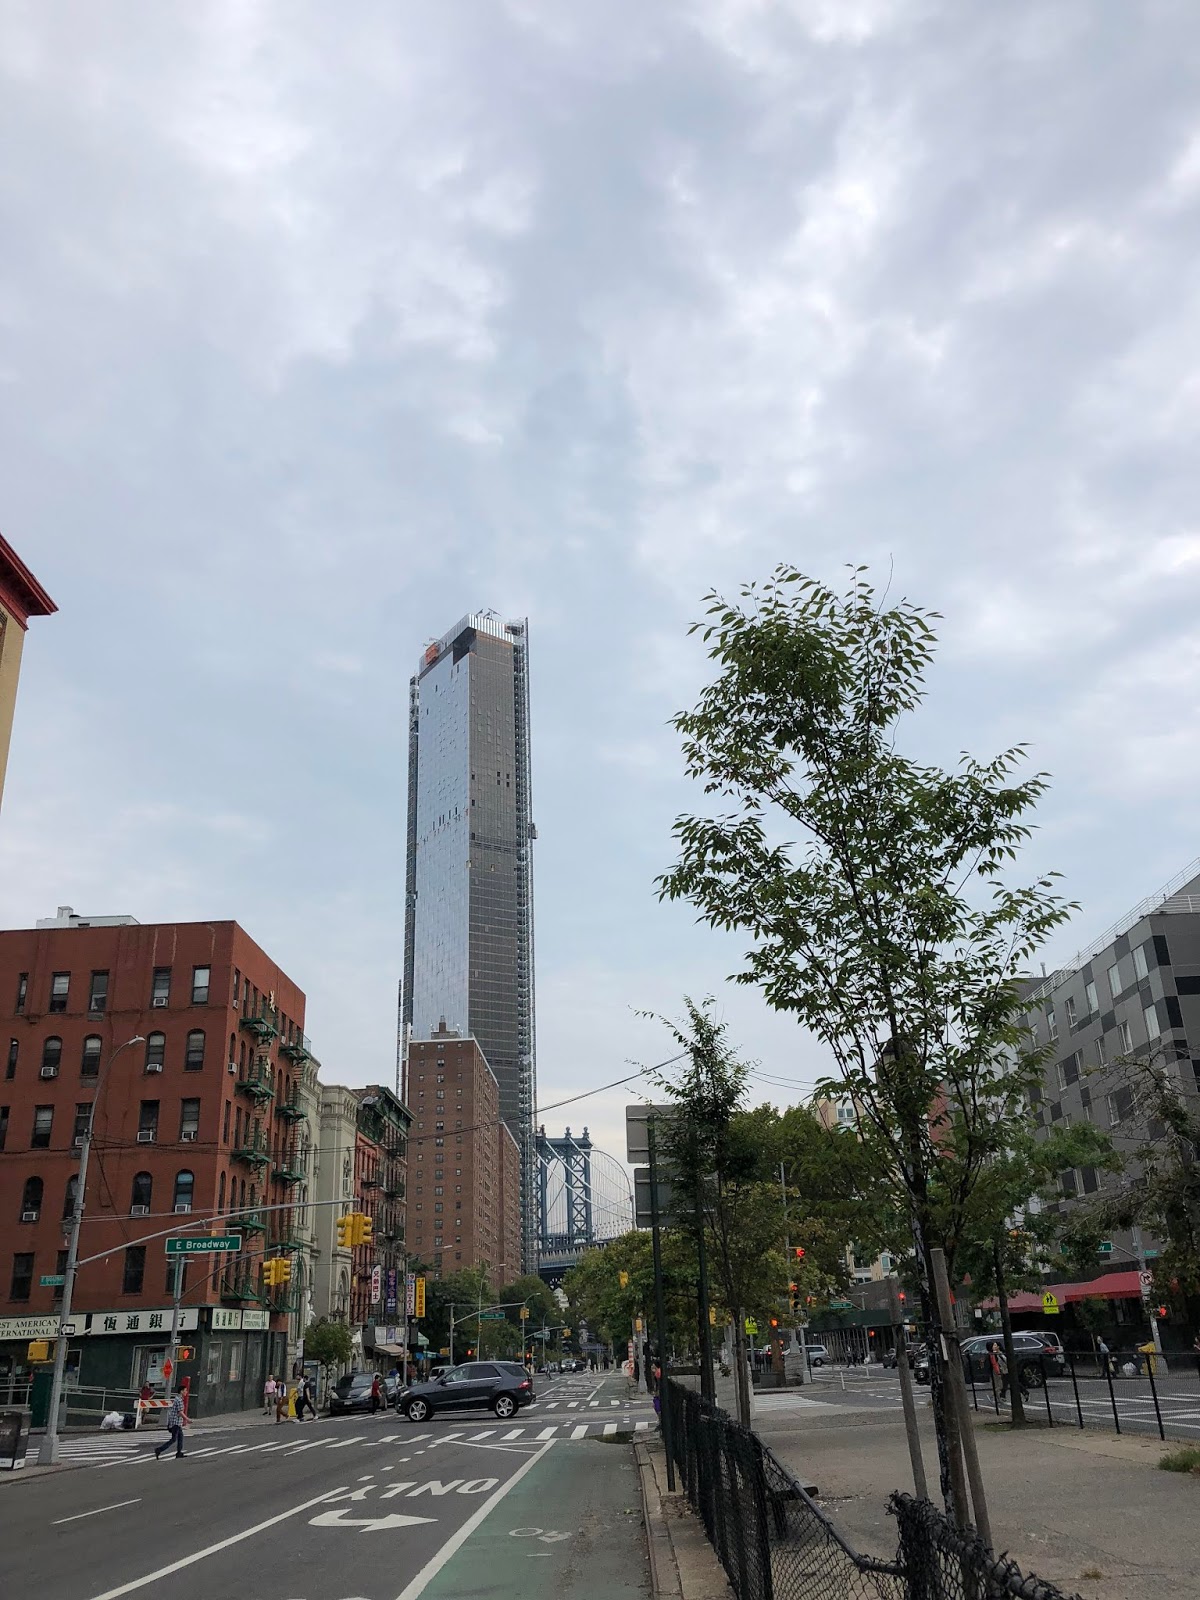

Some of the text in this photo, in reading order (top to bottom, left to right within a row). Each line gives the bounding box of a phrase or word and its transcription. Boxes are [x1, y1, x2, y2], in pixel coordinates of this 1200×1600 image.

[176, 1240, 230, 1249] E Broadway
[0, 1319, 58, 1329] ST AMERICAN
[322, 1478, 499, 1503] ONLY
